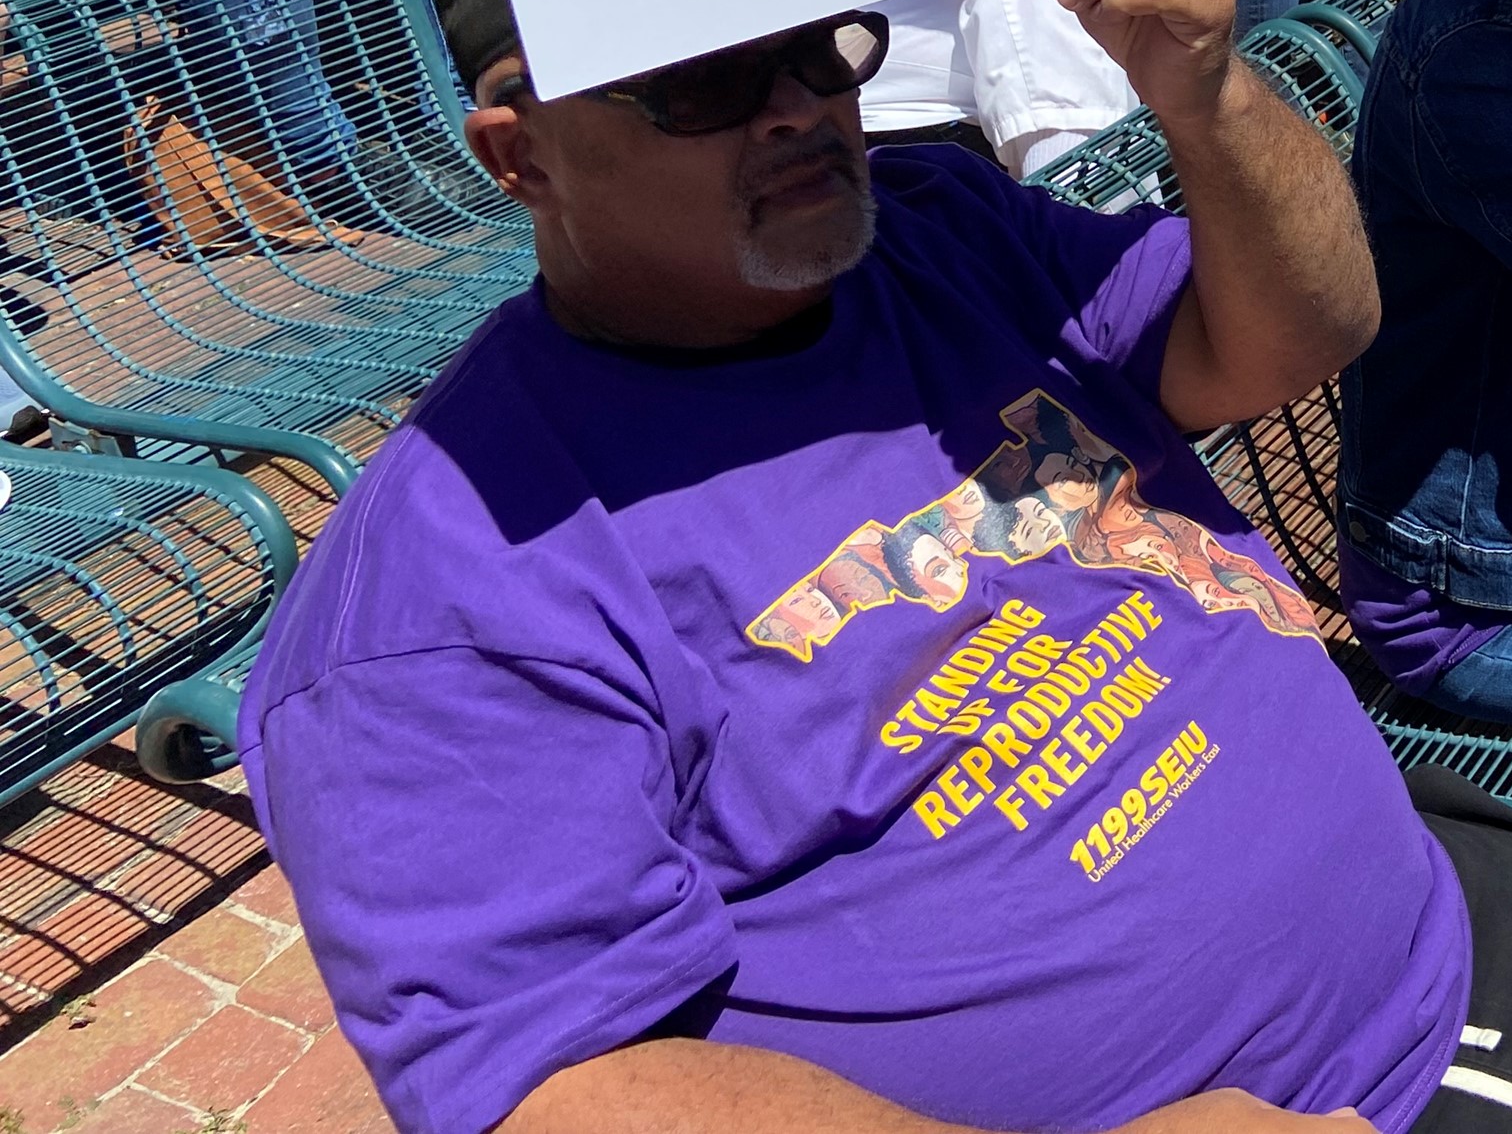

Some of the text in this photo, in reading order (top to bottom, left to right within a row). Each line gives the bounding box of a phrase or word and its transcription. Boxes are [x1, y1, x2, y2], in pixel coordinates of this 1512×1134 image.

[880, 598, 1045, 755] STANDING
[911, 590, 1163, 841] REPRODUCTIVE
[936, 636, 1074, 738] UP FOR
[993, 656, 1172, 833] FREEDOM!
[1069, 720, 1208, 874] 1199SEIU
[1088, 742, 1221, 884] United Healthcare Workers East
